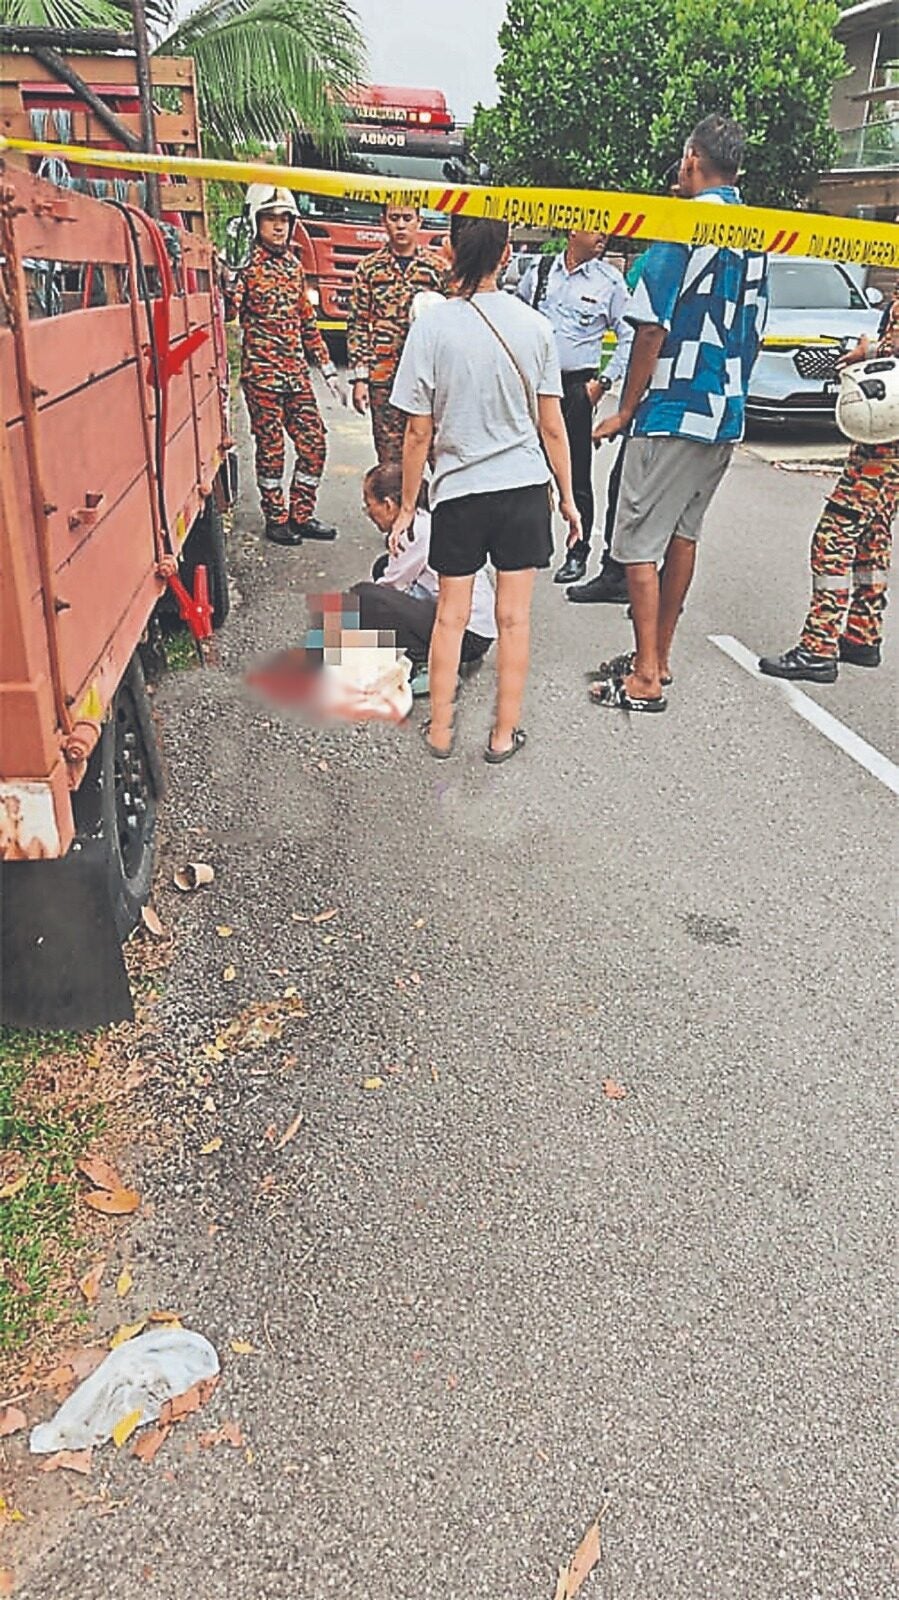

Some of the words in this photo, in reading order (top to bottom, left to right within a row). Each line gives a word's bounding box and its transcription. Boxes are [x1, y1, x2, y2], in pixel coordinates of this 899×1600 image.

[343, 188, 380, 203] AWAS
[483, 195, 545, 227] DILARANG
[547, 203, 611, 231] MERENTAS
[691, 221, 725, 246] AWAS
[728, 224, 765, 249] BOMBA
[807, 234, 861, 262] DILARANG
